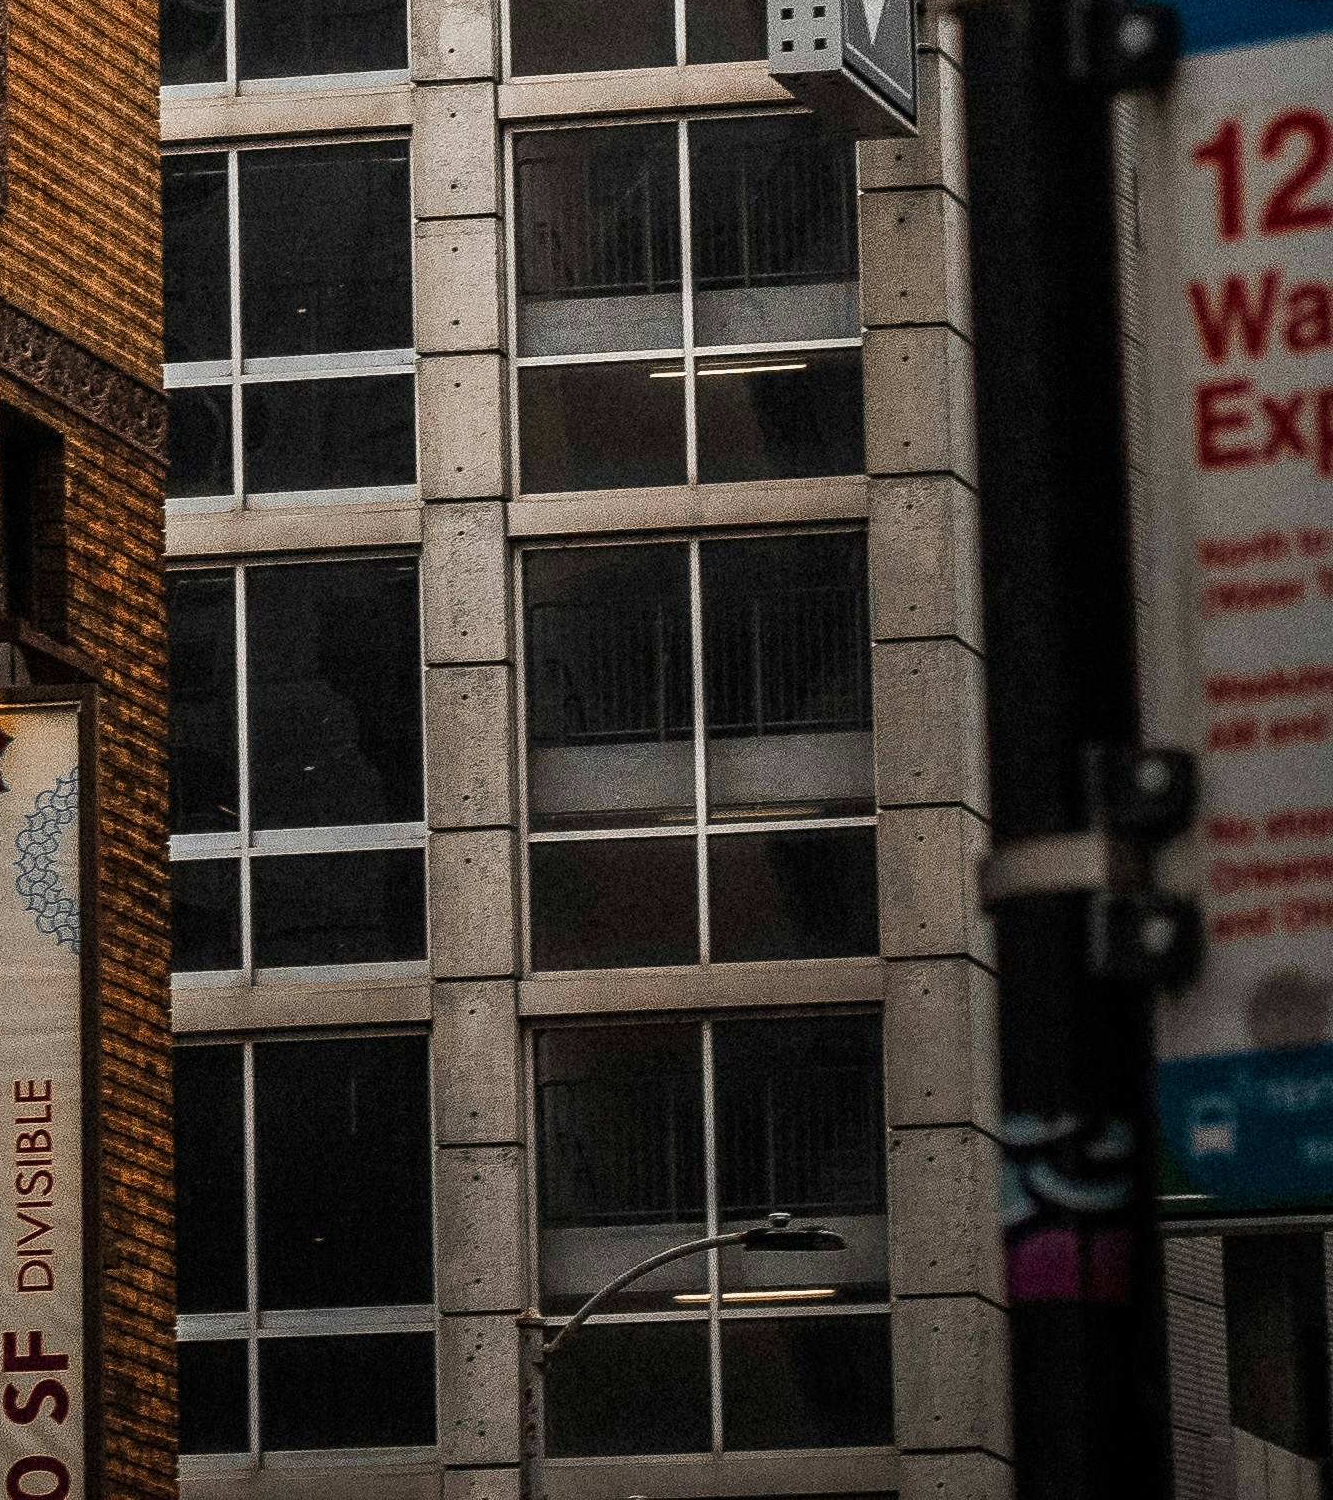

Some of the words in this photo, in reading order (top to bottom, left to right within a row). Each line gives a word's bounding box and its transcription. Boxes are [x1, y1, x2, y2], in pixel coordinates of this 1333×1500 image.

[1193, 107, 1333, 244] 12
[1187, 265, 1333, 366] Wa
[13, 1079, 55, 1293] DIVISIBLE
[2, 1329, 70, 1425] SF
